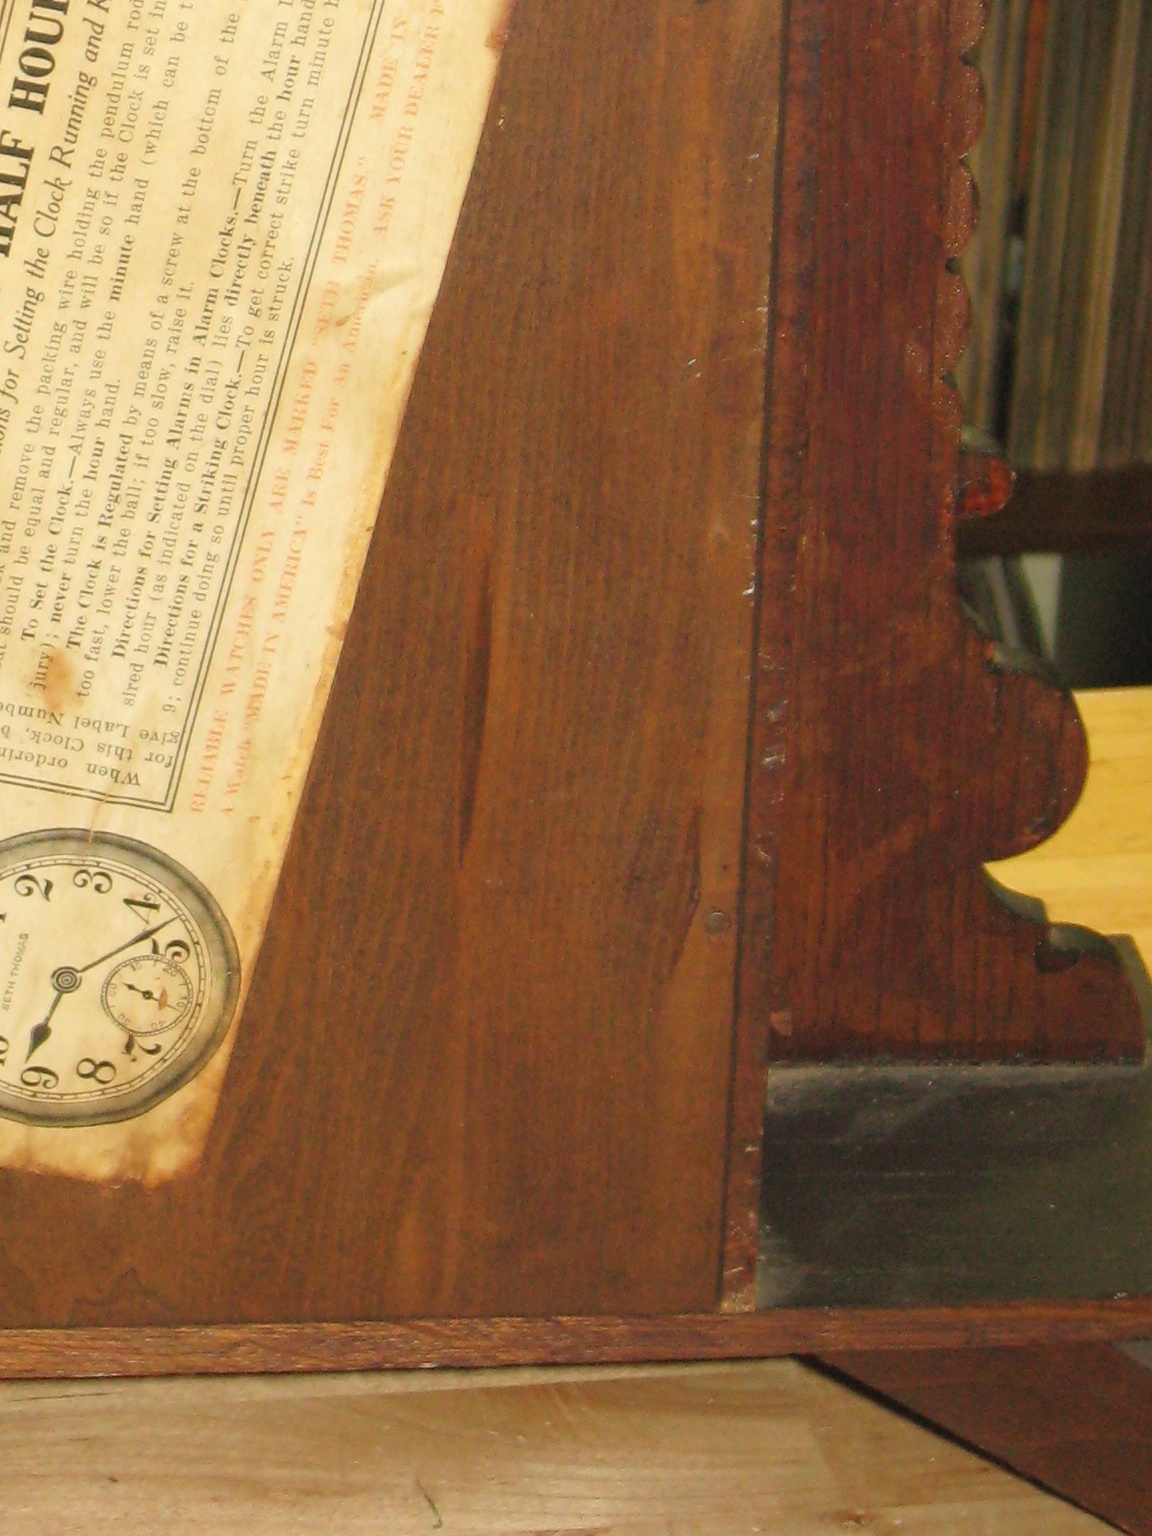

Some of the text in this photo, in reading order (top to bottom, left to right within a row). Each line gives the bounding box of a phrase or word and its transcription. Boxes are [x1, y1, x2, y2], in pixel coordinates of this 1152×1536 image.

[81, 15, 106, 63] and
[99, 41, 134, 139] pendulum
[274, 54, 301, 102] hour
[47, 69, 98, 169] Running
[32, 176, 73, 238] Clock
[242, 149, 277, 224] beneath
[65, 186, 101, 260] holding
[108, 233, 135, 302] minute
[123, 177, 150, 225] hand
[22, 246, 50, 279] the
[222, 232, 257, 307] directly
[304, 438, 332, 483] Best
[368, 192, 397, 238] ASK
[400, 22, 442, 118] DEALER
[23, 486, 46, 537] equal
[48, 362, 79, 436] regular,
[78, 274, 99, 309] will
[117, 89, 144, 143] Clock
[57, 269, 78, 310] wire
[2, 285, 45, 361] Setting
[109, 565, 147, 659] Directions
[145, 456, 179, 524] Setting
[164, 381, 195, 450] Alarms
[191, 287, 219, 347] Alarm
[259, 21, 288, 83] Alarm
[151, 573, 189, 668] Directions
[192, 436, 228, 514] Striking
[256, 212, 284, 280] correct
[275, 148, 301, 205] strike
[290, 97, 315, 138] turn
[306, 17, 334, 87] minute
[164, 307, 187, 354] raise
[210, 315, 233, 348] lies
[35, 320, 67, 396] packing
[76, 558, 103, 609] Clock
[95, 432, 134, 528] Regulated
[132, 337, 158, 397] means
[160, 231, 184, 286] screw
[189, 88, 222, 155] bottom
[149, 362, 176, 410] slow,
[186, 707, 231, 815] RELIABLE
[265, 464, 294, 514] ARE
[280, 358, 321, 456] MARKED
[366, 54, 401, 124] MADE
[8, 443, 35, 510] remove
[172, 608, 202, 686] continue
[191, 550, 219, 602] doing
[216, 472, 238, 516] until
[229, 403, 255, 466] proper
[243, 353, 269, 397] hour
[266, 256, 294, 322] struck.
[49, 571, 72, 624] never
[61, 526, 84, 565] turn
[81, 435, 105, 481] hour
[93, 378, 121, 429] hand.
[155, 481, 191, 565] indicated
[95, 564, 121, 615] lower
[83, 624, 109, 662] fast,
[132, 610, 157, 654] hour
[121, 661, 145, 706] sired
[24, 726, 85, 752] Clock,
[73, 715, 130, 738] Label
[138, 728, 182, 749] give
[85, 762, 141, 787] When
[95, 741, 133, 762] this
[143, 751, 177, 771] for
[11, 871, 56, 902] 2
[71, 864, 113, 894] 3
[117, 895, 161, 926] 4
[145, 933, 194, 965] 5
[17, 1062, 62, 1092] 9
[74, 1056, 117, 1089] 8
